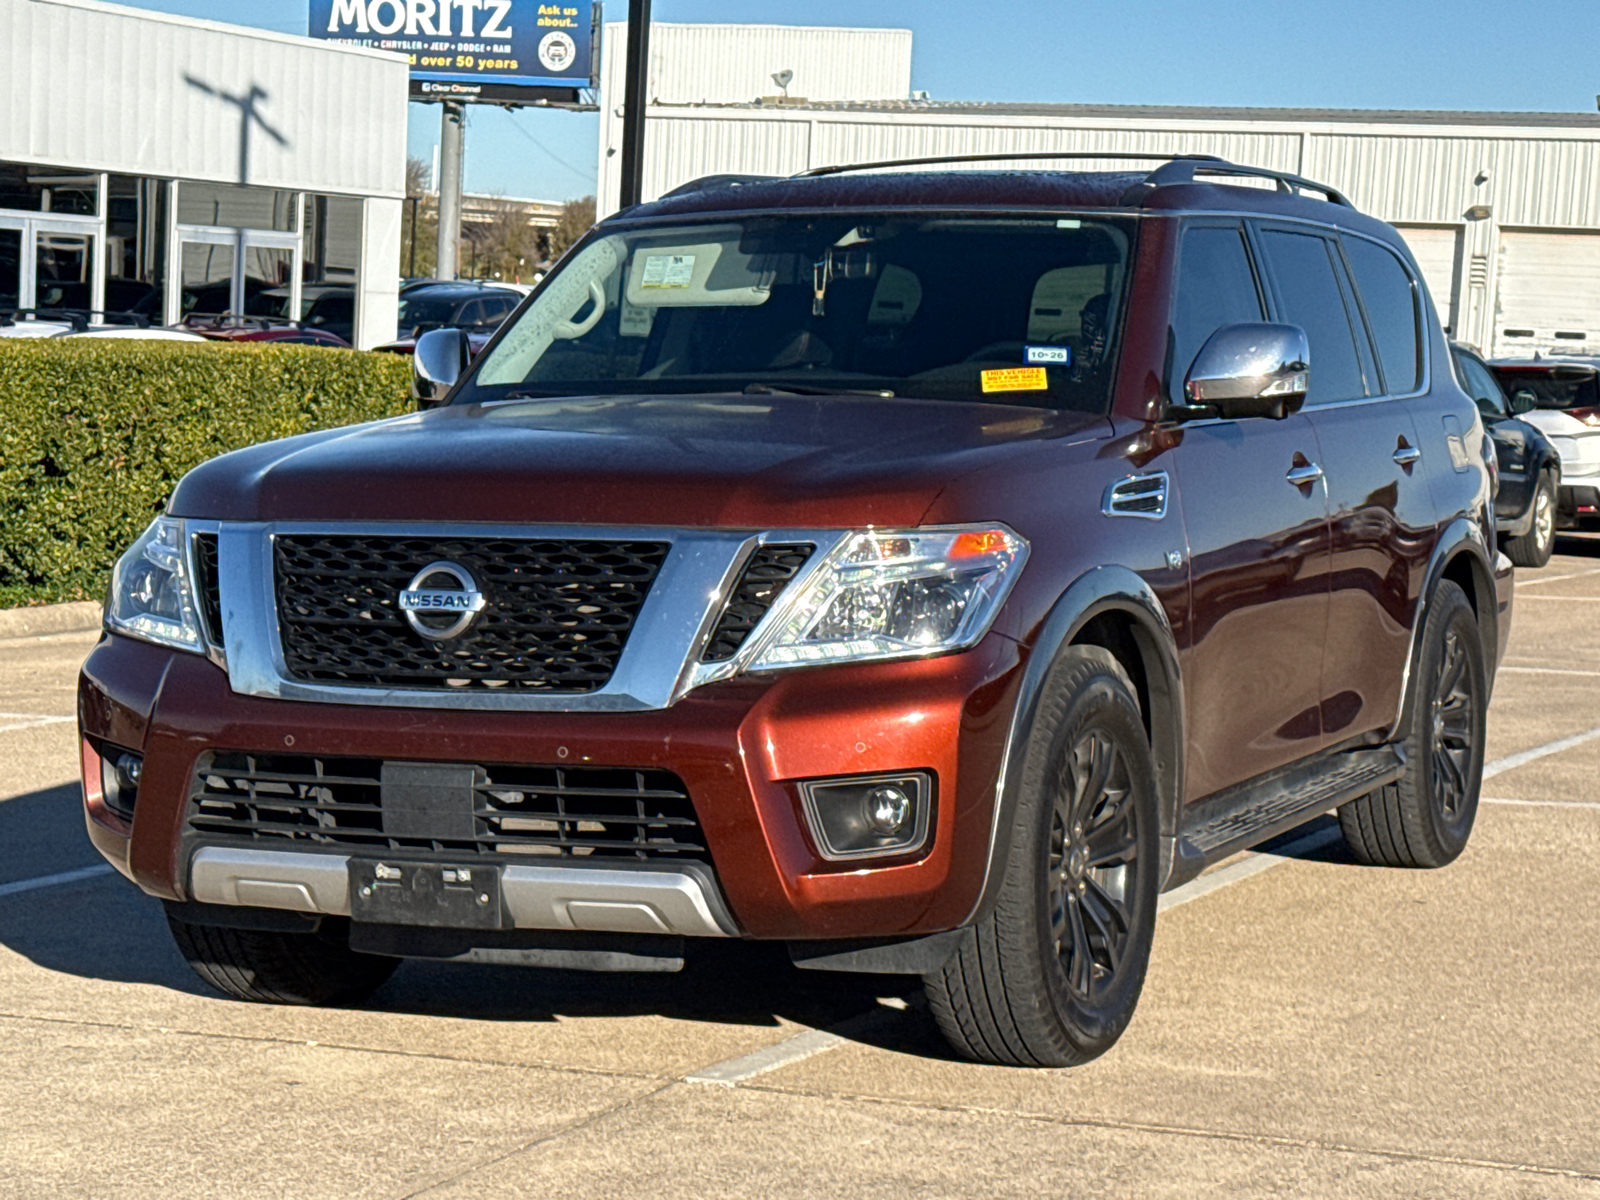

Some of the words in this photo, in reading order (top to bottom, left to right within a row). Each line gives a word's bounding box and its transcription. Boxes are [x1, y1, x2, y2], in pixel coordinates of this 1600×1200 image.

[538, 4, 561, 15] Ask
[563, 8, 579, 16] us
[327, 0, 513, 38] MORITZ
[380, 39, 422, 50] CHRYSLER
[429, 42, 450, 51] JEEP
[457, 42, 485, 53] DODGE
[492, 44, 512, 53] RAM
[420, 57, 453, 67] over
[456, 56, 474, 67] 50
[478, 58, 519, 71] years
[431, 83, 451, 92] Clear
[451, 84, 482, 93] Channel
[404, 594, 470, 607] NISSAN
